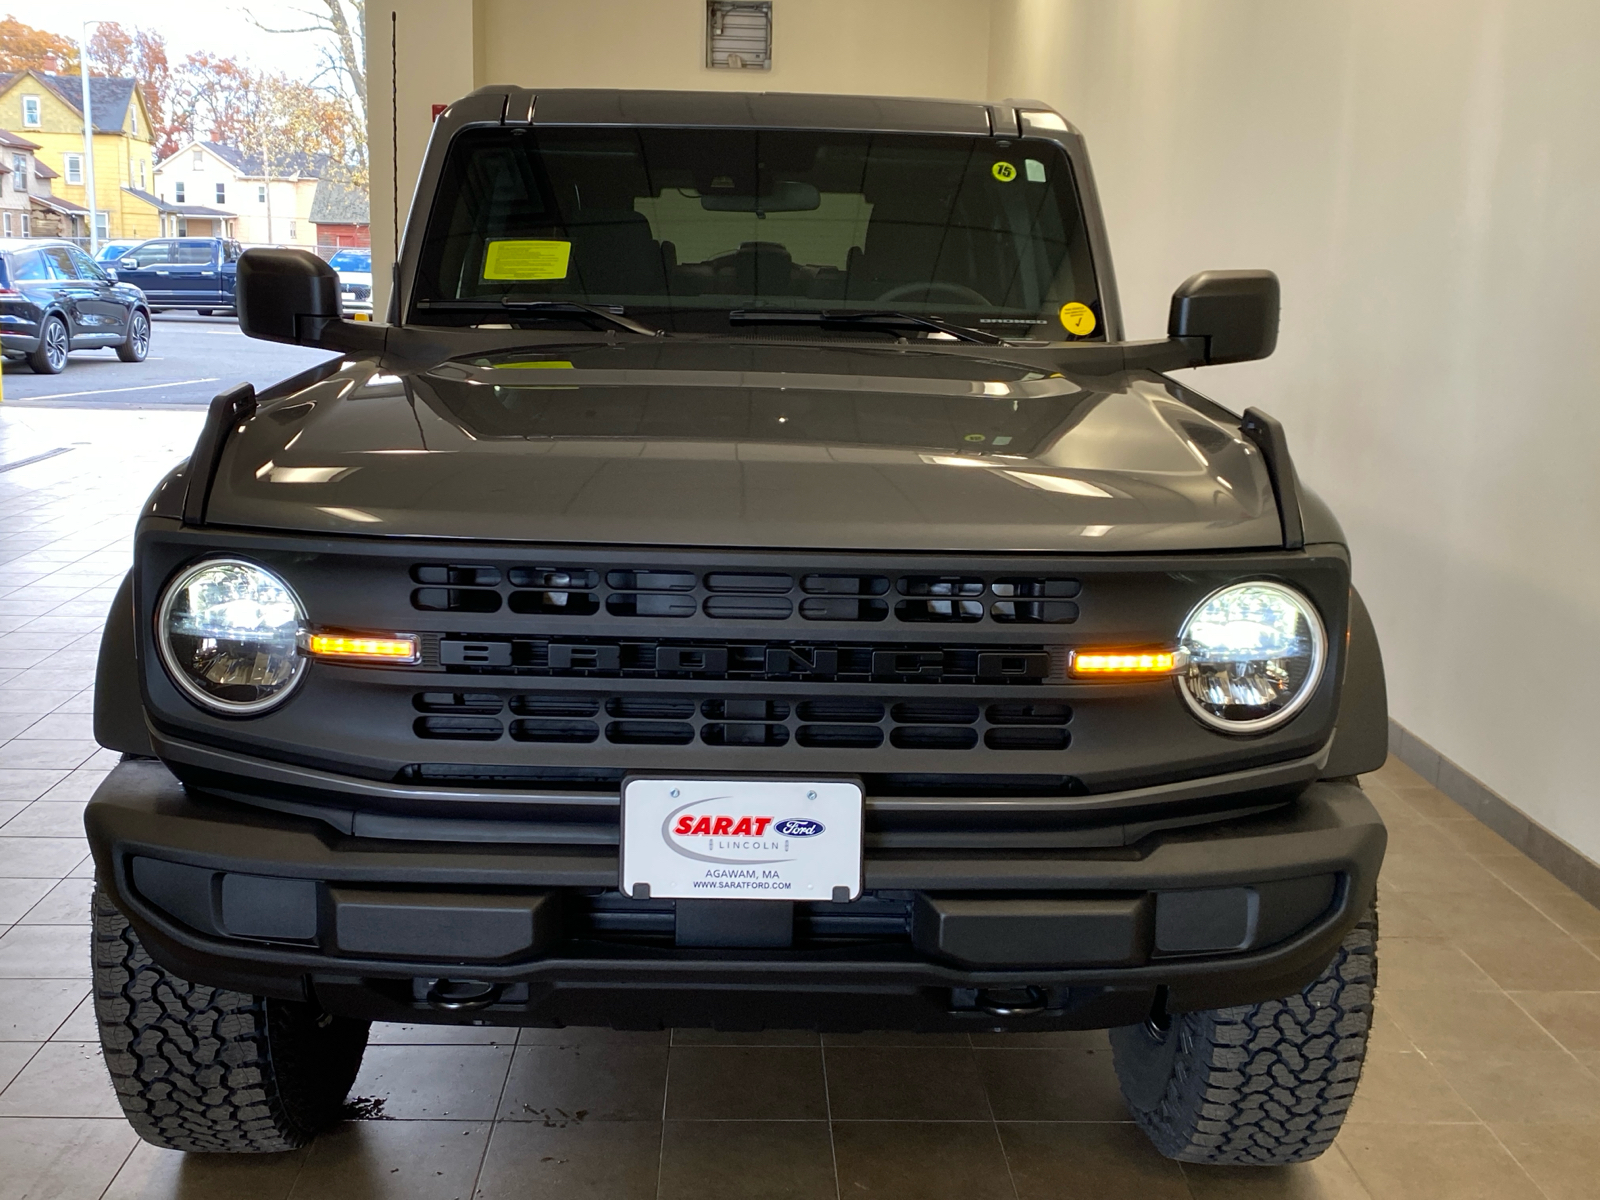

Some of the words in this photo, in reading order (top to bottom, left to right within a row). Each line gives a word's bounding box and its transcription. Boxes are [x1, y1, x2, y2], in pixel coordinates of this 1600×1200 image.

[997, 164, 1013, 178] 15
[440, 639, 1051, 679] BRONCO
[673, 814, 775, 837] SARAT
[783, 820, 816, 836] Ford
[719, 841, 779, 850] LINCOLN
[705, 869, 760, 880] AGAWAM,
[762, 870, 780, 879] MA
[693, 881, 792, 890] WWW.SARATFORD.COM
